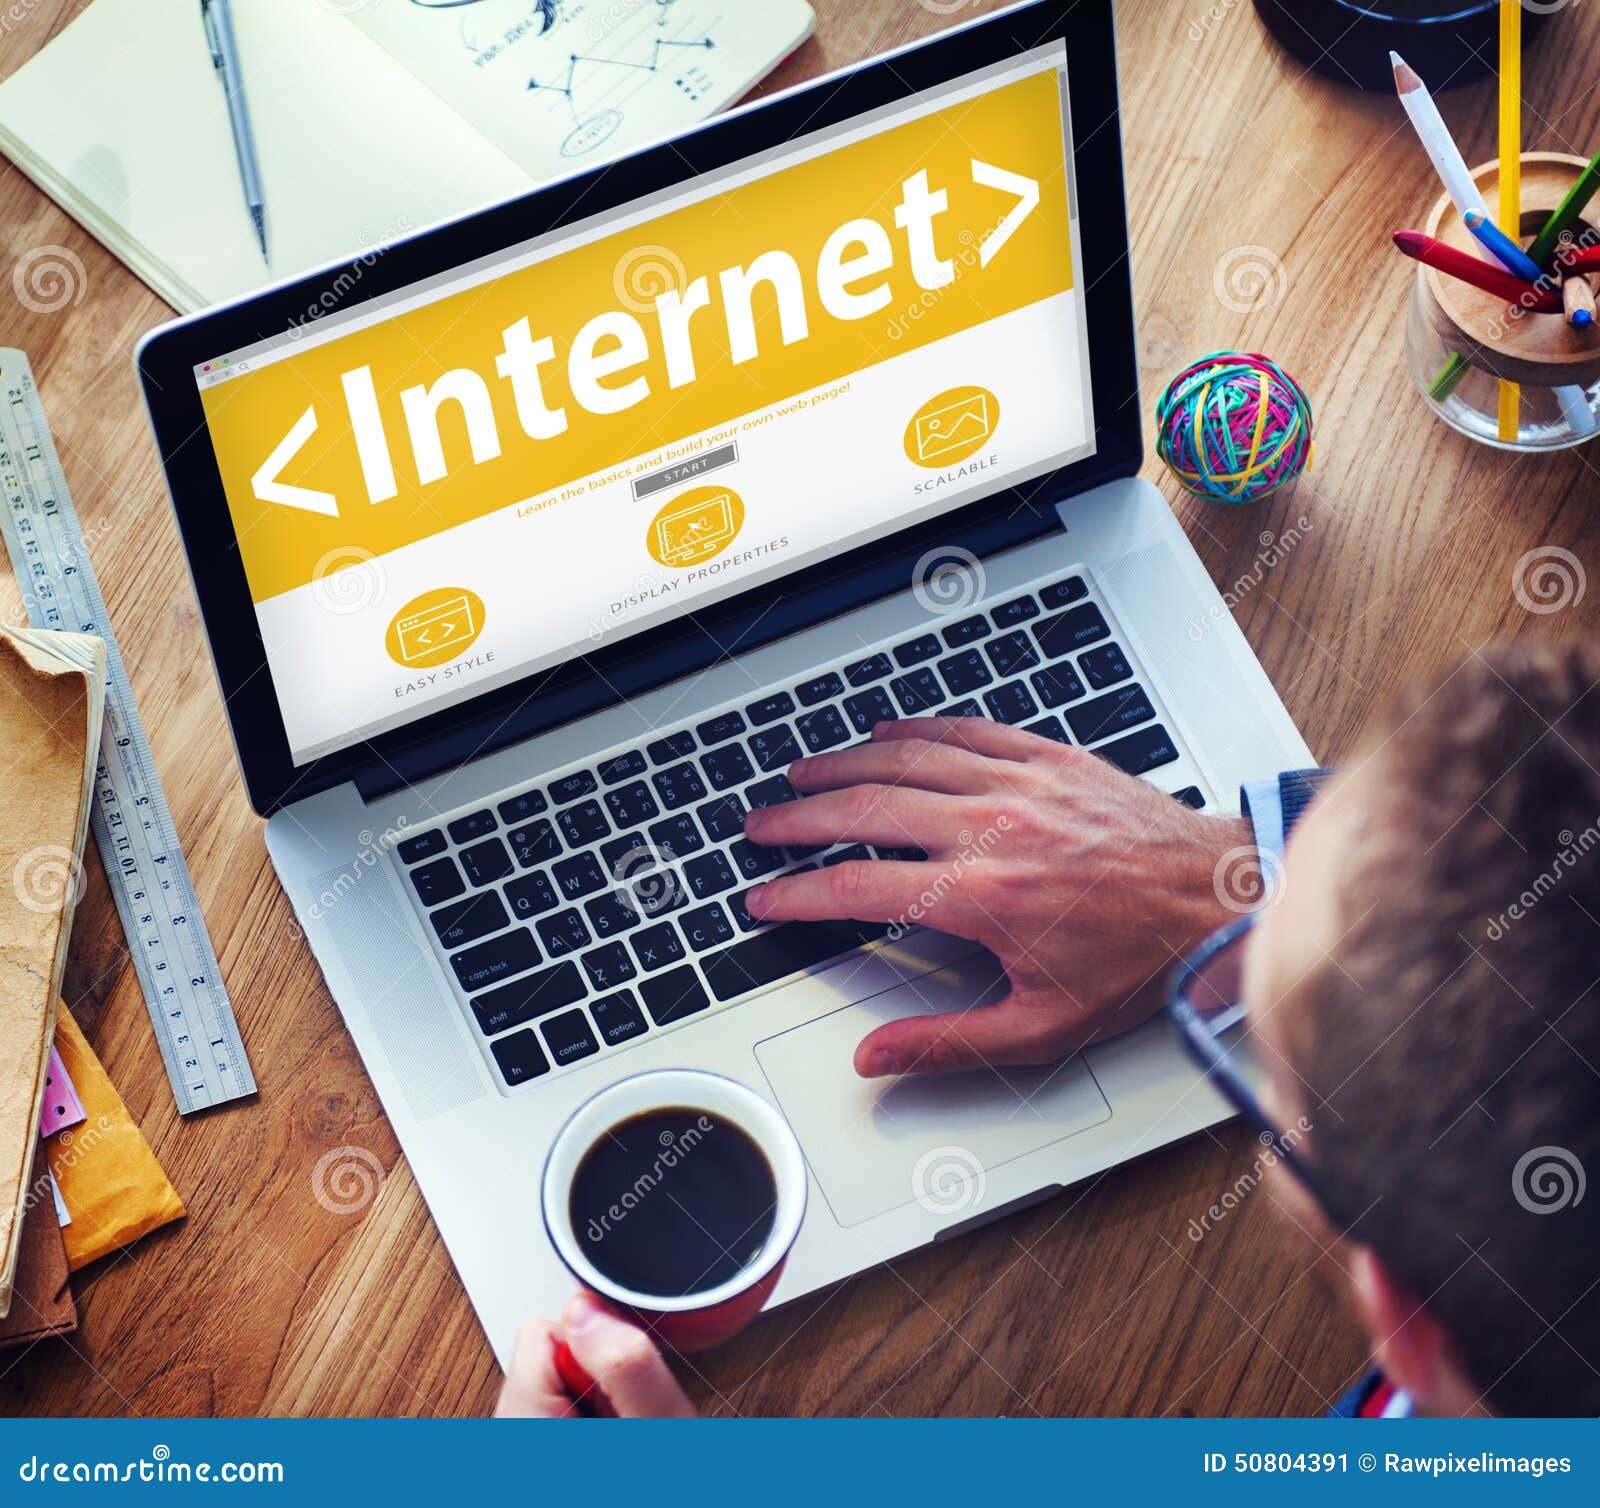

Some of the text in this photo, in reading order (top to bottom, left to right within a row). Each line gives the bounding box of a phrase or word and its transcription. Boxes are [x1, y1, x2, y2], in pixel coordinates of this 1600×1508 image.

[516, 381, 852, 519] Learn the basics and build your own web page!
[663, 458, 709, 482] START
[913, 454, 998, 495] SCALABLE
[43, 500, 58, 516] 10
[609, 535, 790, 614] DISPLAY PROPERTIES
[1073, 624, 1101, 641] delete
[393, 650, 497, 698] EASY STYLE
[857, 713, 866, 725] 9
[1120, 706, 1146, 721] return
[117, 737, 131, 747] 6
[809, 732, 820, 744] 8
[1150, 746, 1169, 761] shift
[715, 770, 724, 781] 6
[666, 789, 676, 800] 5
[136, 796, 149, 806] 5
[109, 812, 123, 827] 12
[619, 808, 629, 819] 4
[710, 820, 721, 833] T
[569, 828, 580, 839] 3
[117, 836, 131, 851] 11
[661, 840, 674, 852] R
[154, 855, 167, 864] 4
[744, 858, 757, 870] G
[120, 857, 138, 876] 10
[564, 876, 581, 891] W
[694, 878, 705, 890] F
[134, 891, 145, 900] 9
[517, 897, 532, 910] Q
[647, 897, 659, 909] D
[141, 914, 152, 923] 8
[172, 915, 187, 926] 3
[598, 916, 609, 929] S
[448, 927, 464, 939] tab
[693, 929, 705, 942] C
[148, 939, 160, 947] 7
[551, 936, 563, 949] A
[643, 948, 657, 963] X
[155, 962, 167, 971] 6
[468, 960, 509, 982] caps lock
[594, 968, 607, 982] Z
[191, 976, 206, 987] 2
[163, 986, 174, 996] 5
[171, 1010, 182, 1019] 4
[488, 1010, 509, 1025] shift
[608, 1021, 636, 1037] option
[177, 1034, 189, 1044] 3
[211, 1037, 224, 1048] 1
[558, 1039, 589, 1057] control
[185, 1058, 197, 1068] 2
[511, 1066, 523, 1076] fn
